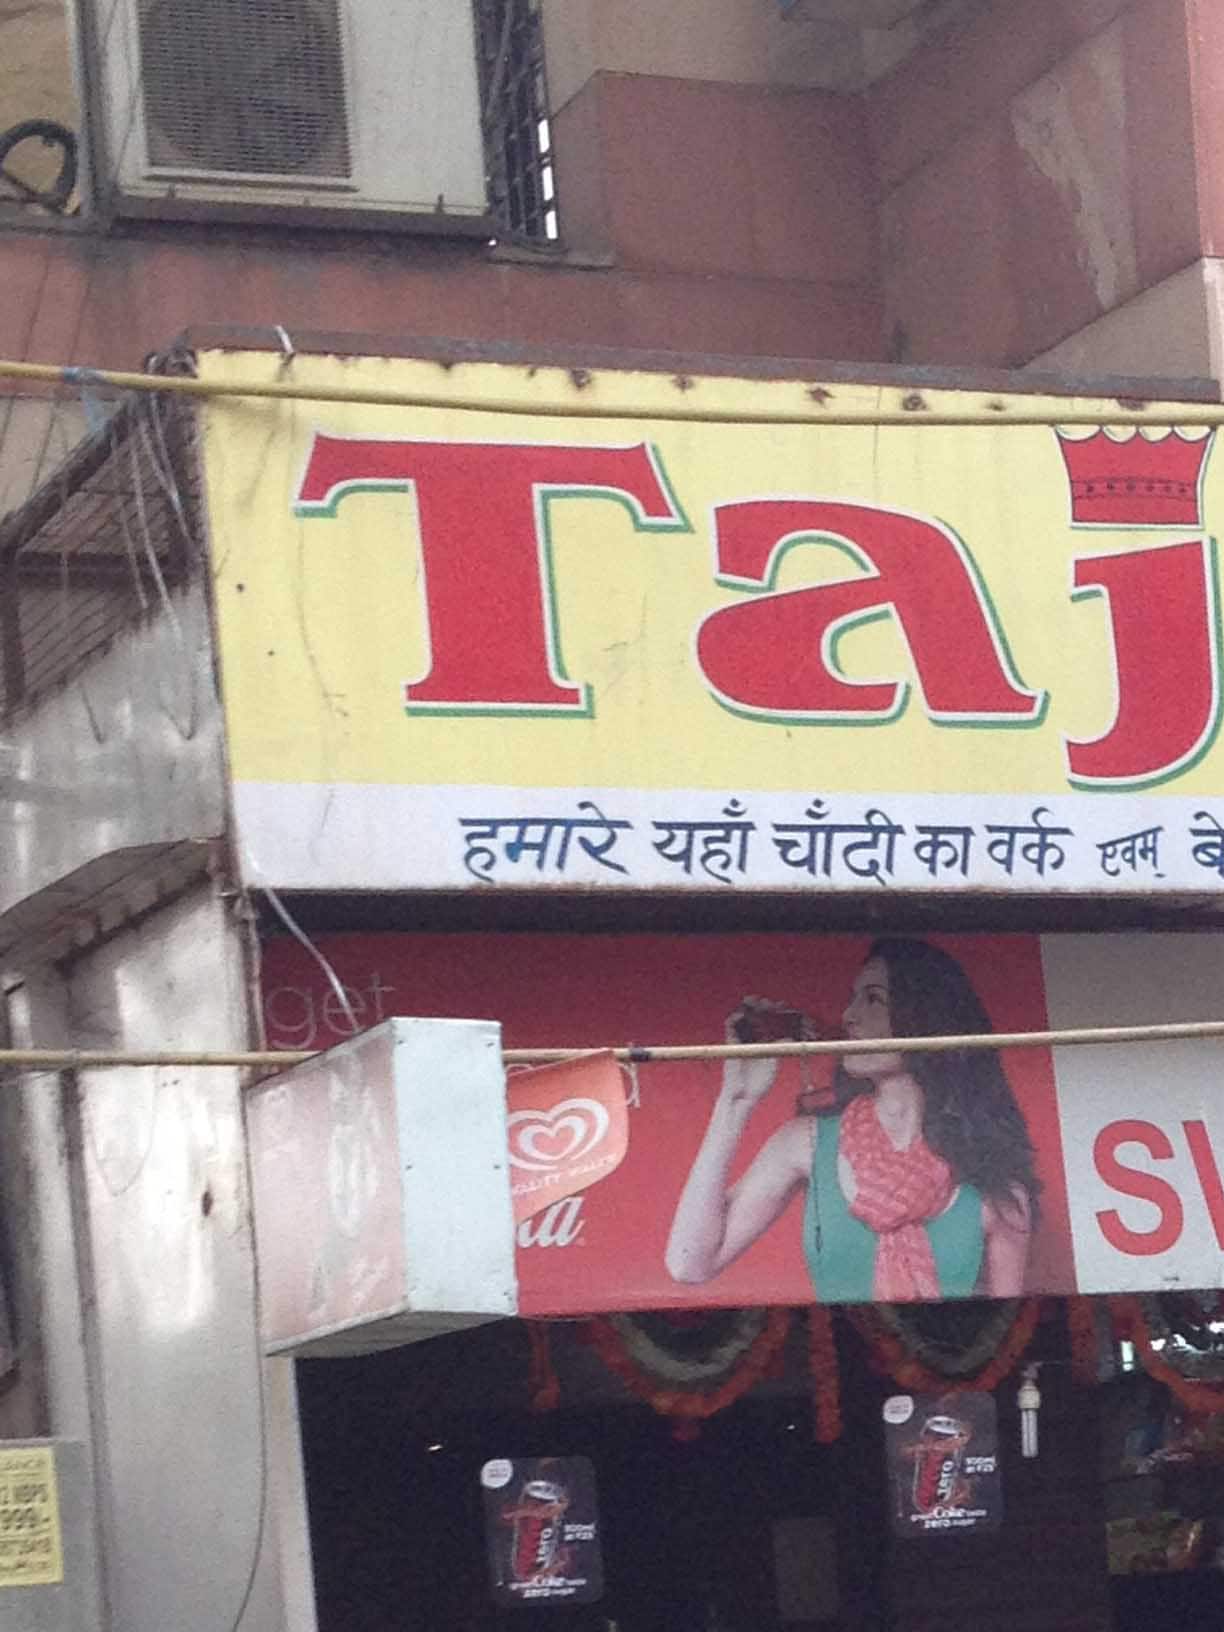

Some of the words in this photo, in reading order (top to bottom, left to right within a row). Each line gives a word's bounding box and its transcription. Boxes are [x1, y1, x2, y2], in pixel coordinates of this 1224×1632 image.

[459, 801, 633, 882] हमारे
[652, 799, 756, 884] यहाँ
[772, 799, 904, 885] चाँदी
[916, 825, 975, 877] का
[985, 806, 1073, 876] वर्क
